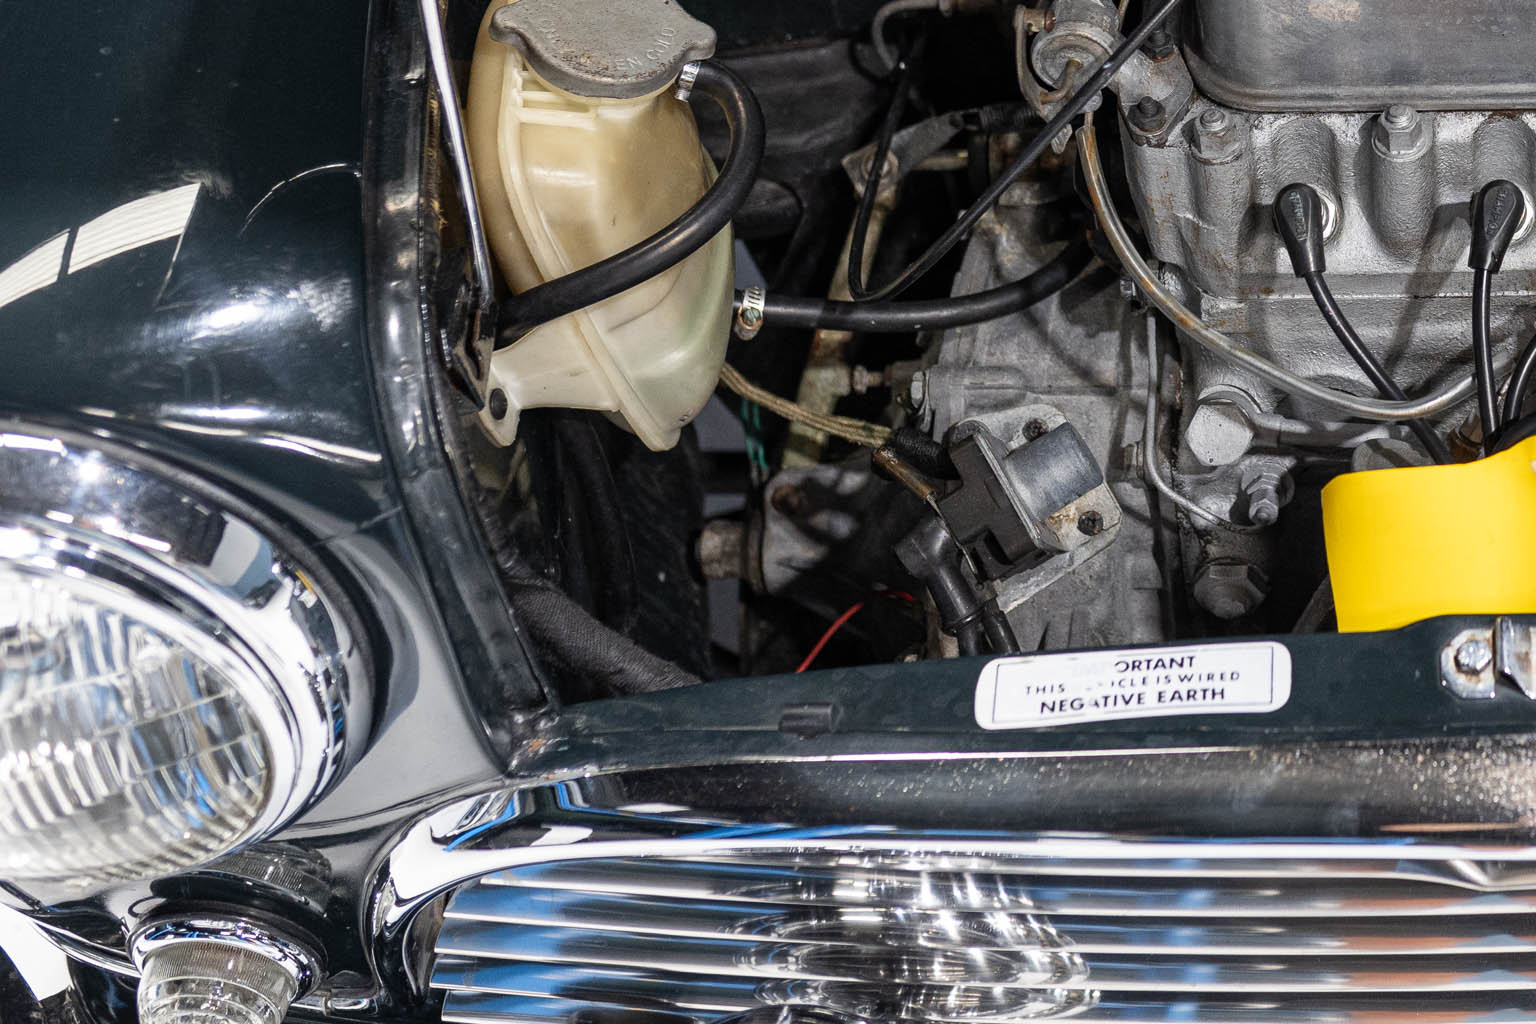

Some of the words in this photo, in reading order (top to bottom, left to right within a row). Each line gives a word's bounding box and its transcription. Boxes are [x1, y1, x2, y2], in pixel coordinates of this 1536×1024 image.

[1026, 682, 1065, 695] THIS
[1156, 674, 1172, 686] IS
[1178, 671, 1240, 684] WIRED
[1157, 688, 1225, 704] EARTH
